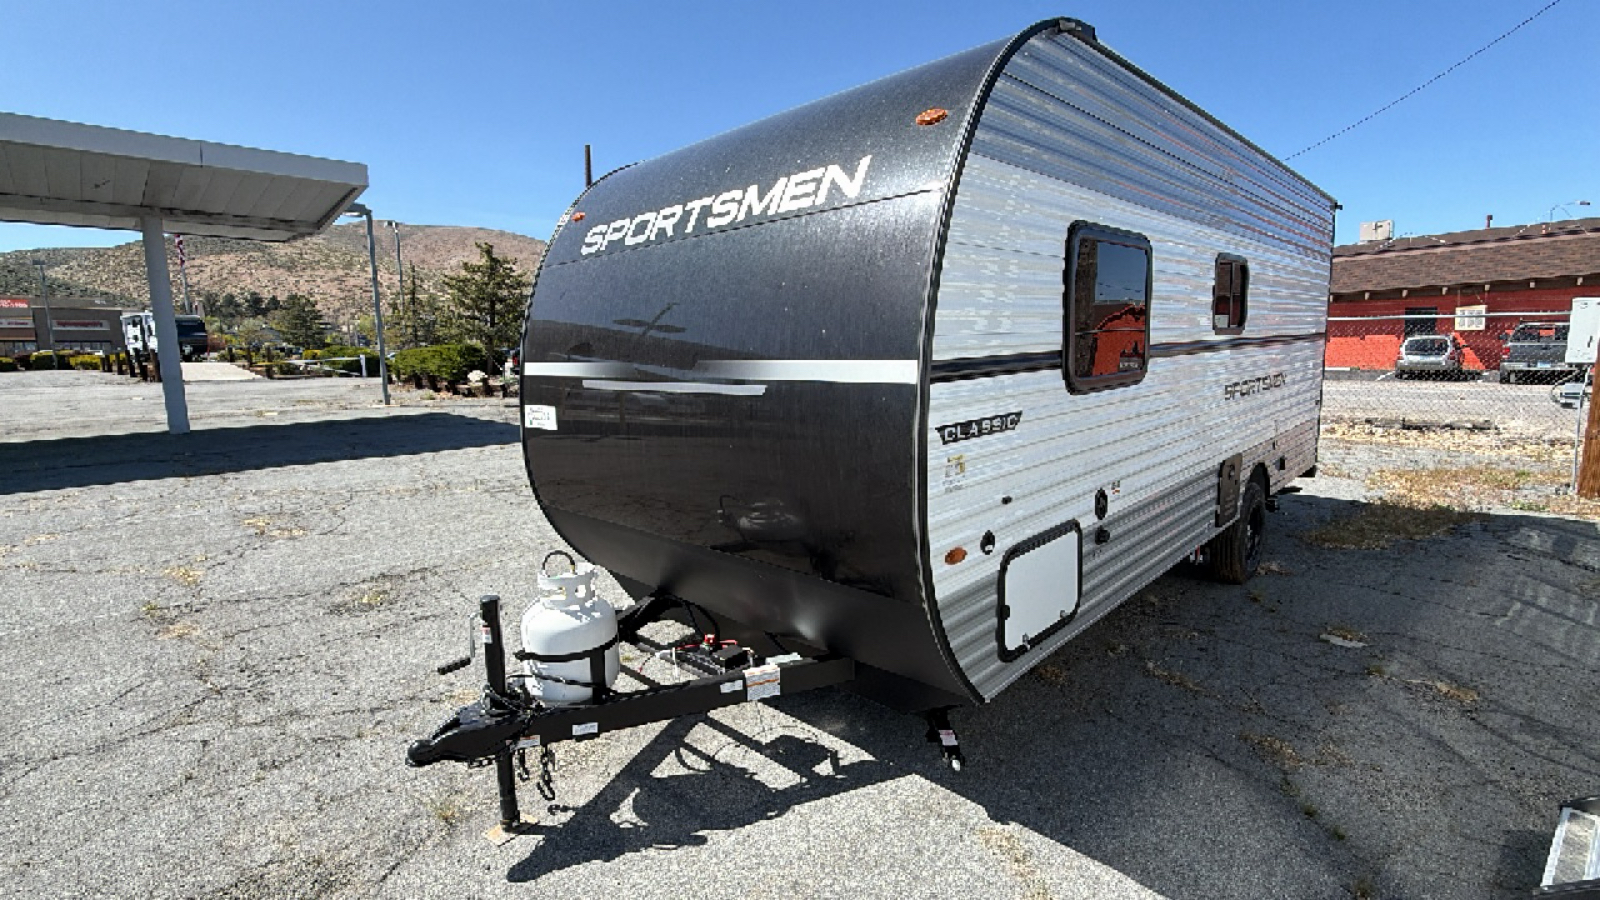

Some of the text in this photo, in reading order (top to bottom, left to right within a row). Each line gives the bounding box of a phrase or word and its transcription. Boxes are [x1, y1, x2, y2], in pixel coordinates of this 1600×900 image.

[581, 154, 872, 256] SPORTSMEN
[1225, 372, 1287, 400] SPORTSMEN
[943, 414, 1018, 442] CLASSIC
